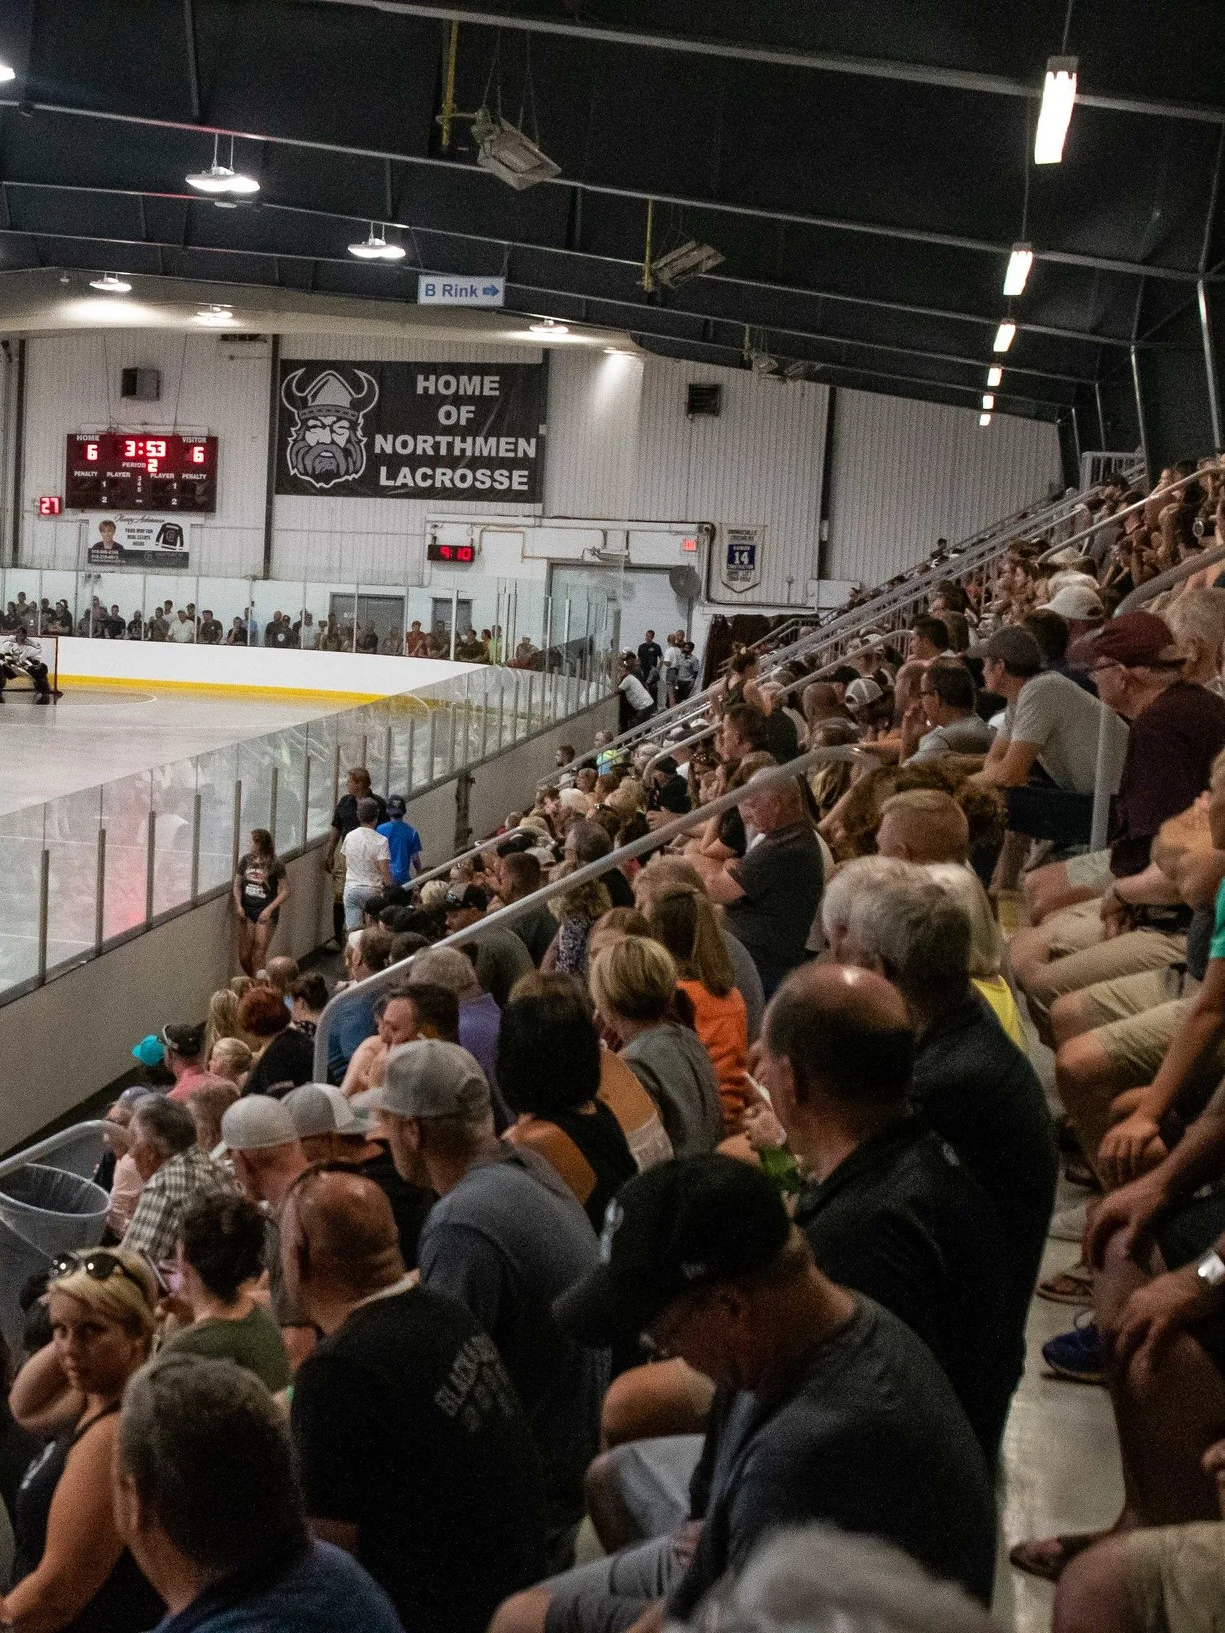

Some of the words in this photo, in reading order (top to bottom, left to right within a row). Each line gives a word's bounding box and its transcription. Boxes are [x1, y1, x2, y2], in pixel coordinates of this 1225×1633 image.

[425, 284, 436, 297] B
[442, 285, 478, 298] Rink
[416, 374, 500, 396] HOME
[438, 405, 475, 425] OF
[182, 436, 207, 444] VISITOR
[375, 434, 537, 458] NORTHMEN
[87, 444, 98, 461] 6
[125, 440, 167, 458] 3:53
[193, 446, 205, 463] 6
[147, 458, 159, 473] 2
[379, 466, 529, 490] LACROSSE
[40, 497, 60, 514] 27
[734, 551, 749, 565] 14
